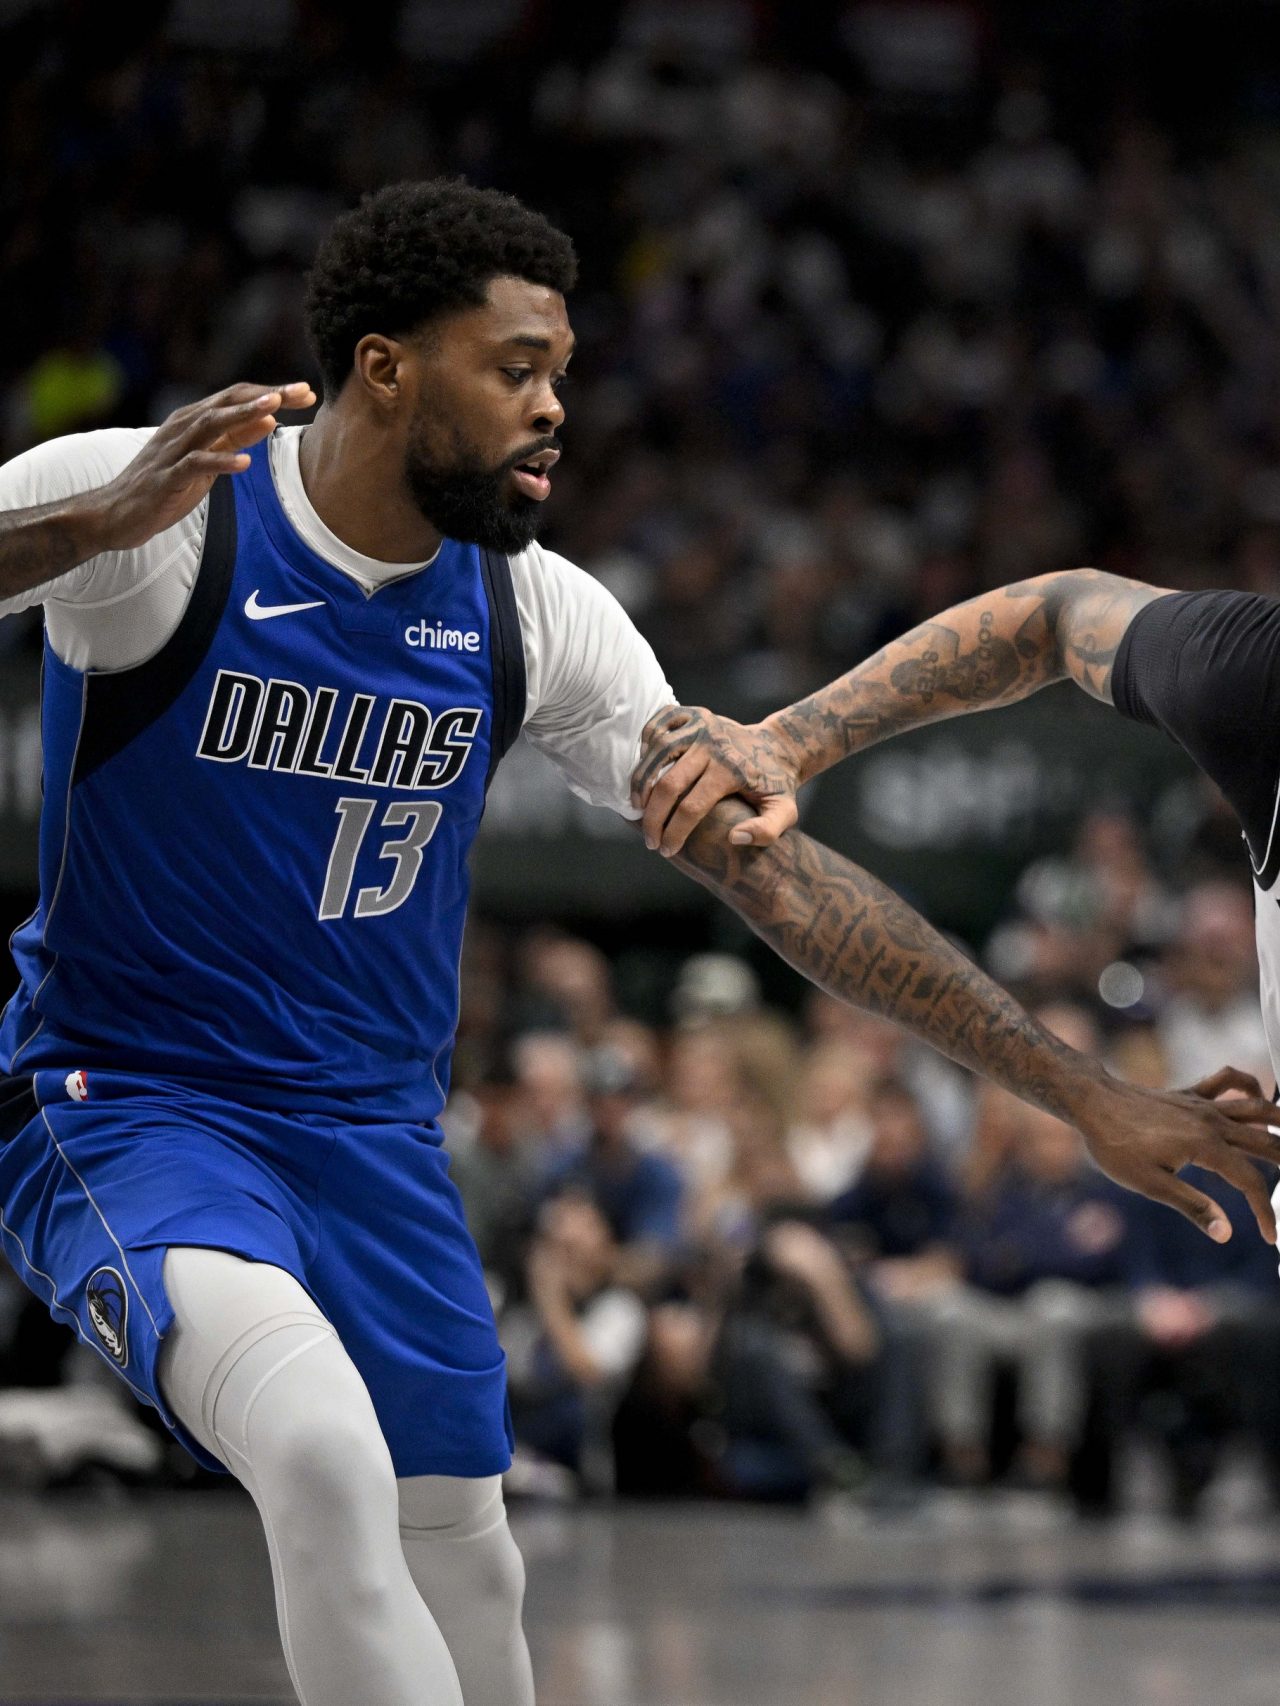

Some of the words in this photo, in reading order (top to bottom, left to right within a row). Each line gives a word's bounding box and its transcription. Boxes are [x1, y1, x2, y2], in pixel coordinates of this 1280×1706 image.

[405, 620, 480, 652] chime
[196, 669, 484, 791] DALLAS
[318, 797, 443, 921] 13
